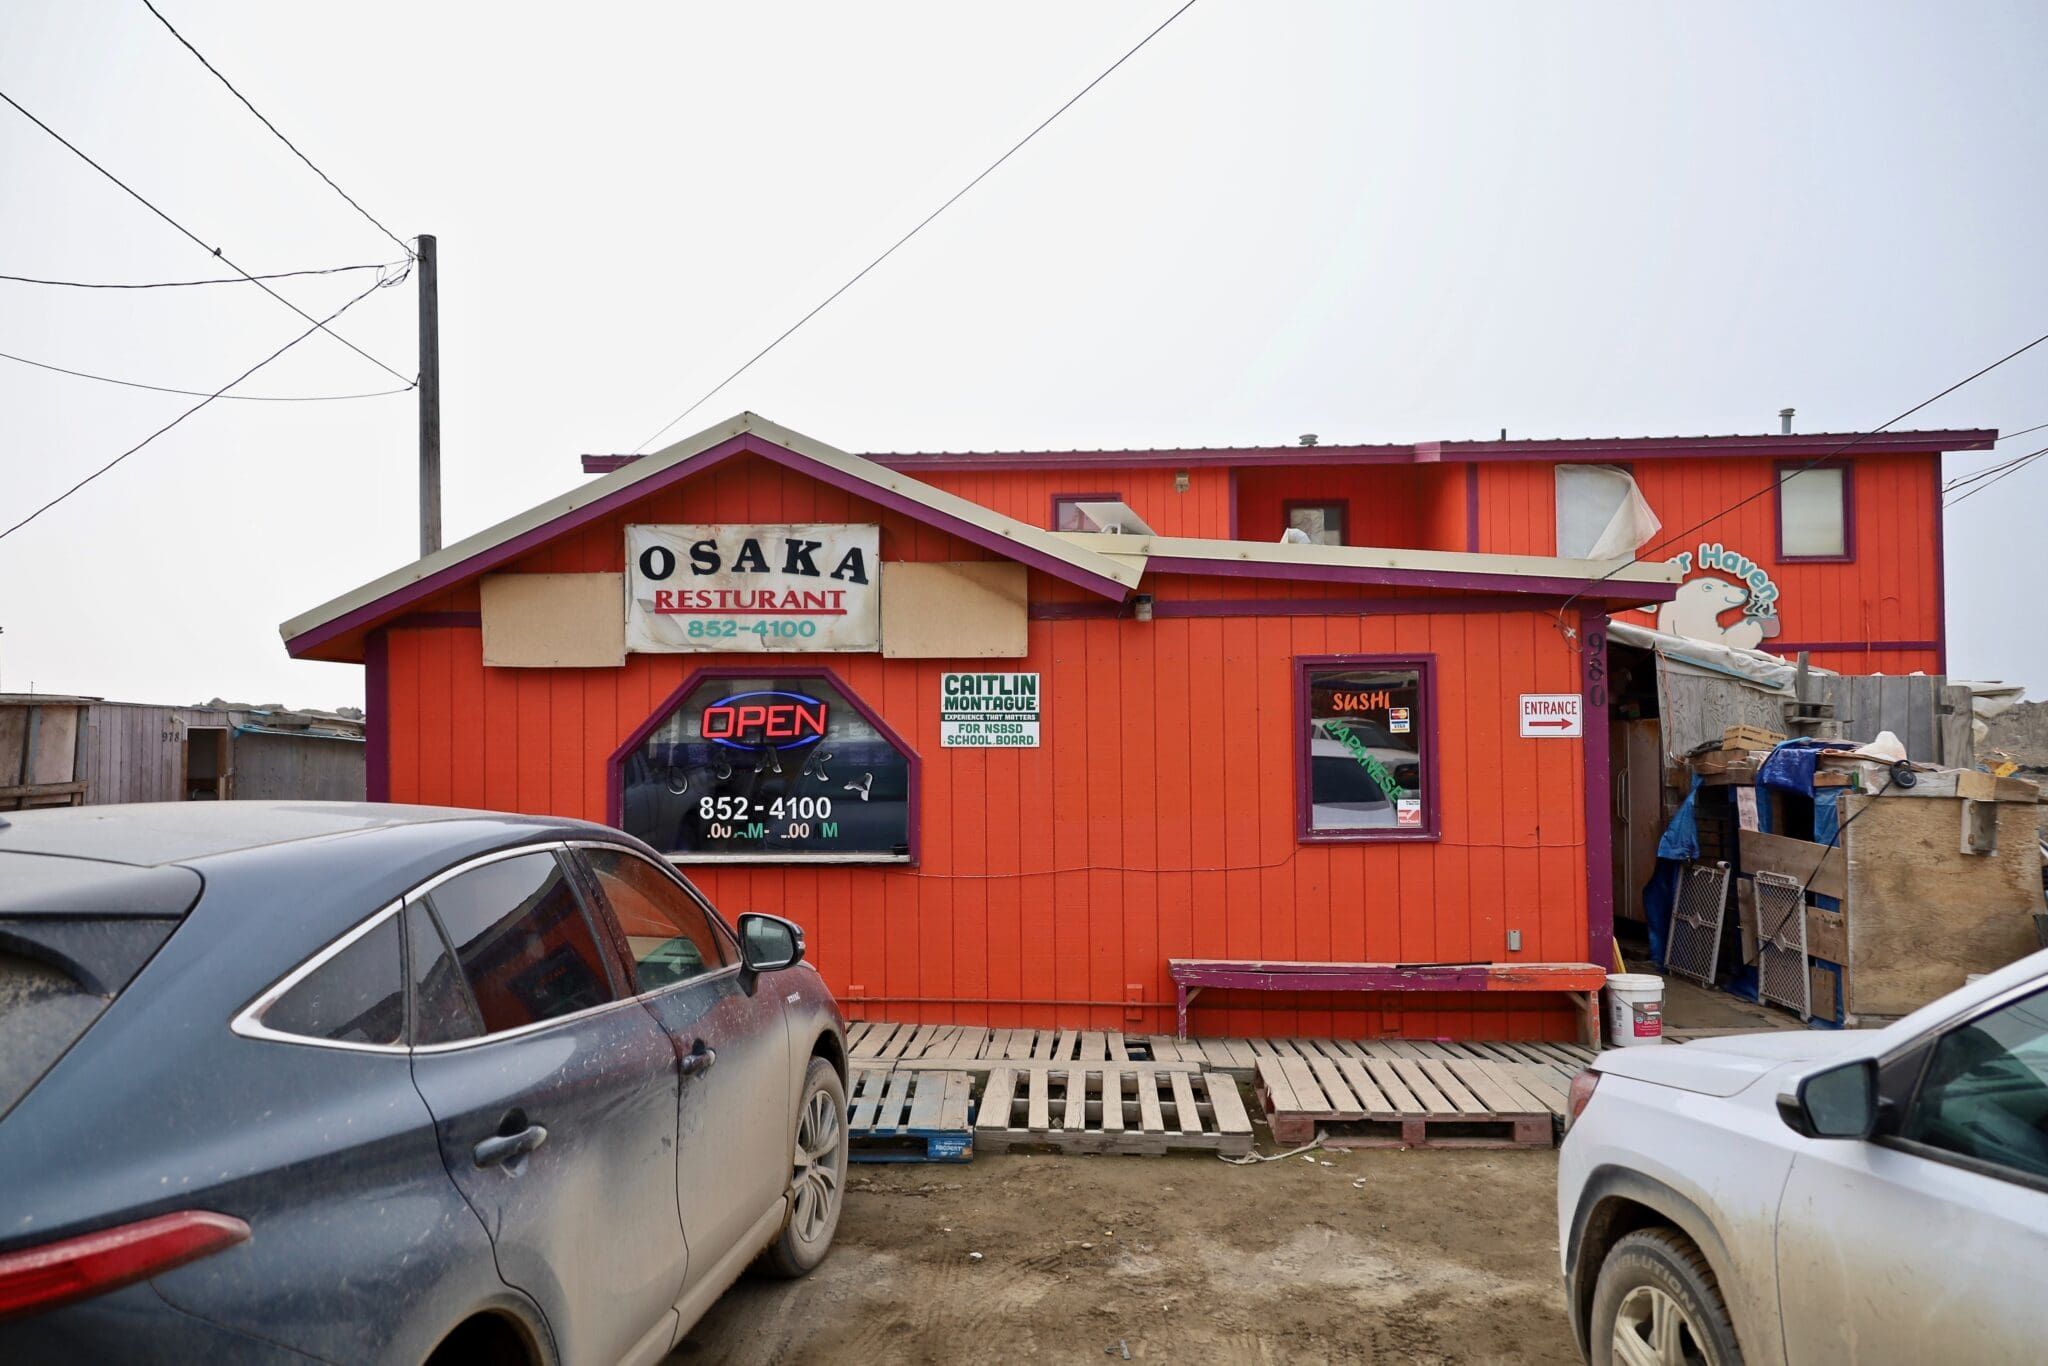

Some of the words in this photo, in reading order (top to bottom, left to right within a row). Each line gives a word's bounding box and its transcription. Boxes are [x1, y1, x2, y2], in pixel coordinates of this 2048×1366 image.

[639, 538, 869, 585] OSAKA
[1699, 544, 1778, 601] Haven
[655, 590, 847, 609] RESTURANT
[687, 620, 816, 638] 852-4100
[1588, 633, 1605, 707] 980
[945, 674, 1036, 695] CAITLIN
[945, 696, 1036, 711] MONTAGUE
[1333, 690, 1390, 711] SUSHI
[1525, 701, 1577, 715] ENTRANCE
[702, 704, 827, 738] OPEN
[958, 724, 980, 733] FOR
[985, 724, 1023, 733] NSBSD
[161, 732, 180, 743] 978
[947, 735, 992, 745] SCHOOL
[996, 735, 1034, 745] BOARD
[1324, 719, 1407, 803] JAPANESE
